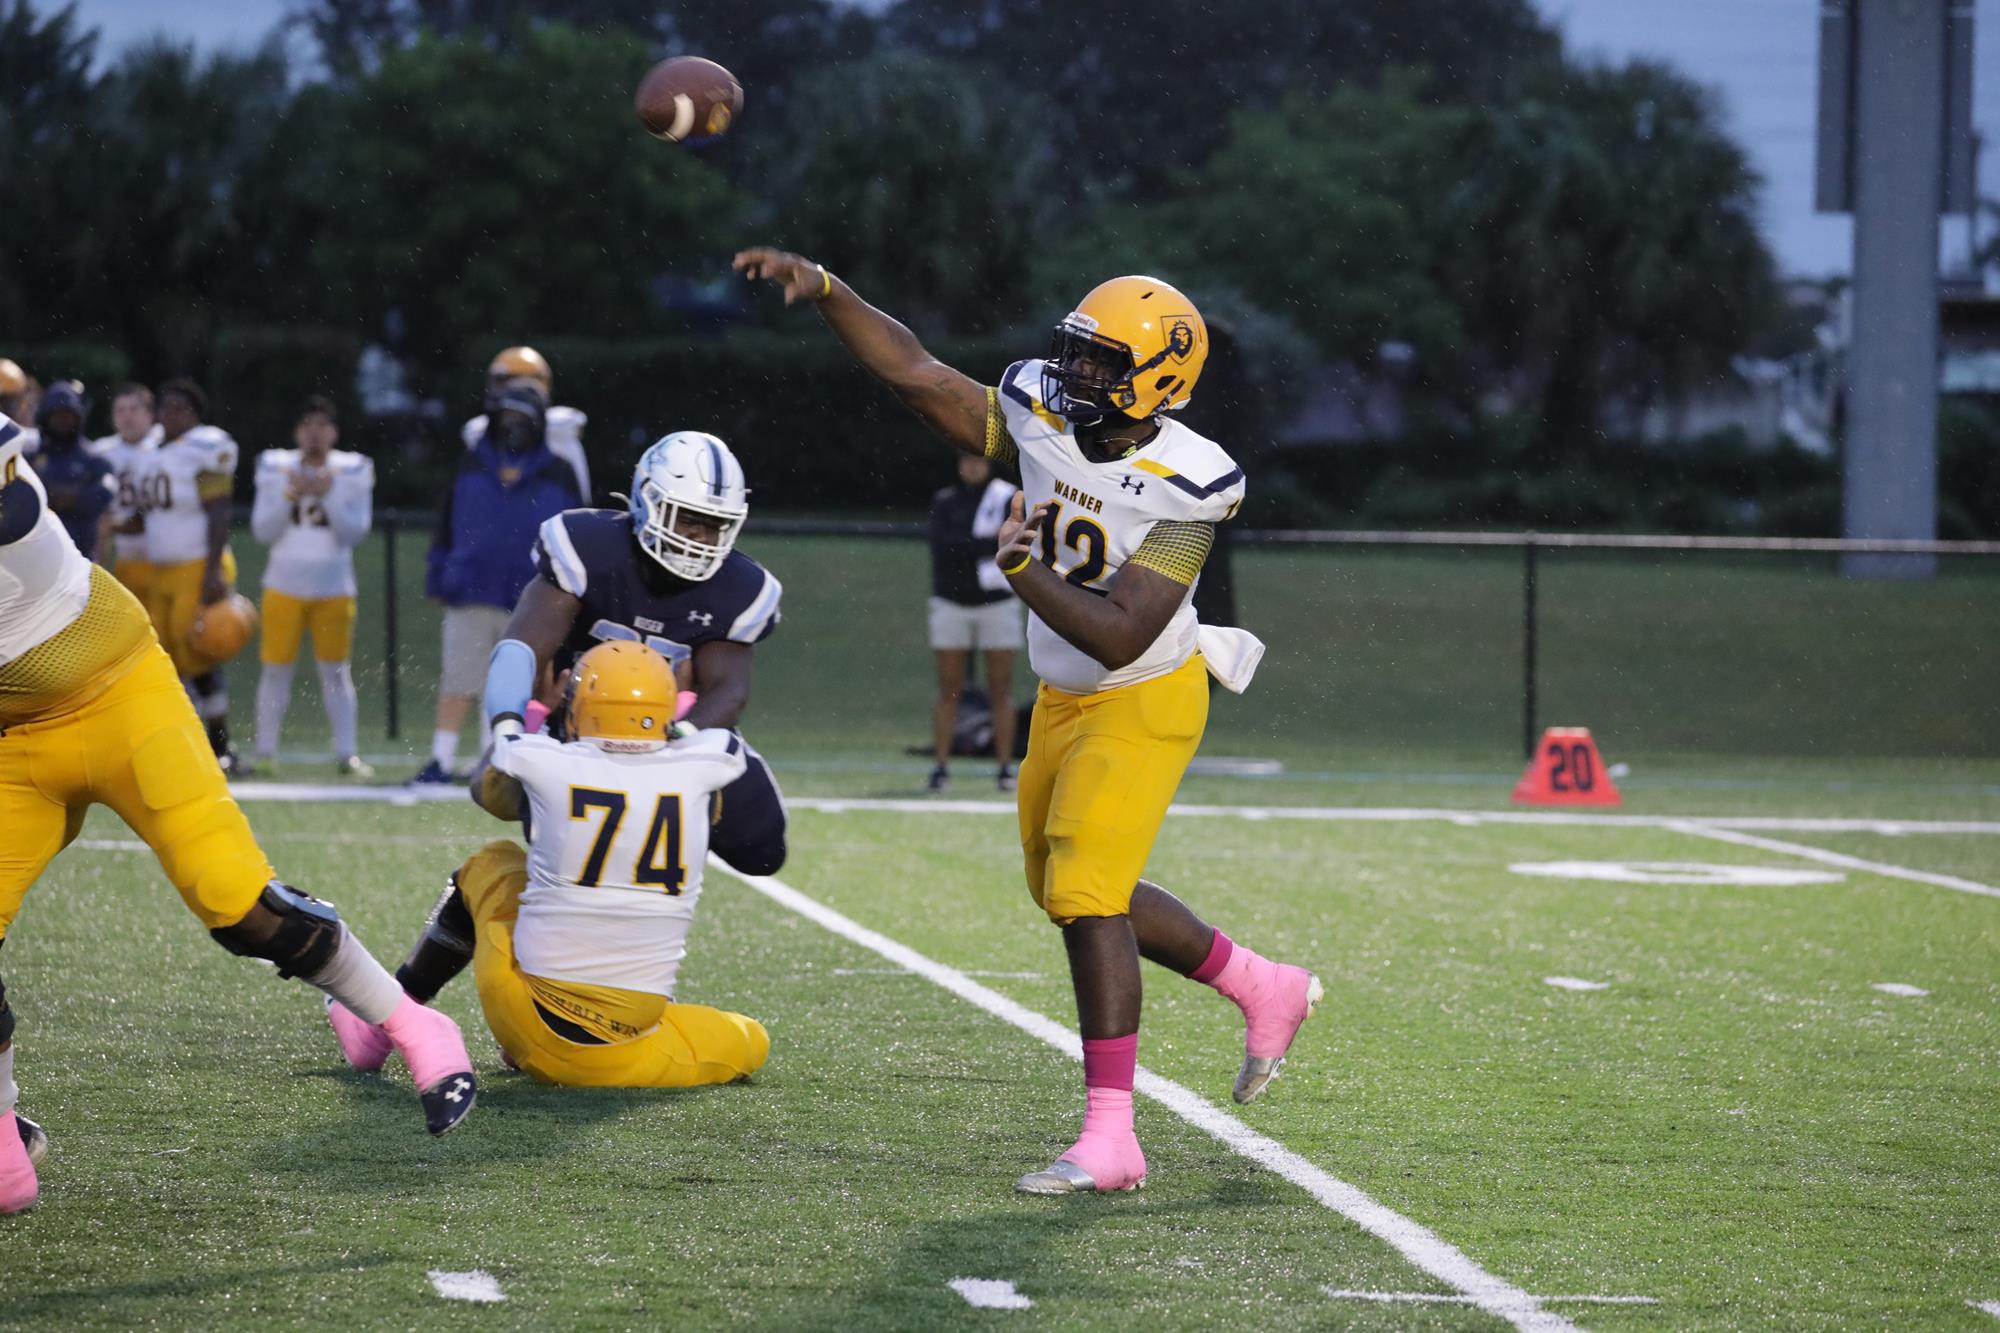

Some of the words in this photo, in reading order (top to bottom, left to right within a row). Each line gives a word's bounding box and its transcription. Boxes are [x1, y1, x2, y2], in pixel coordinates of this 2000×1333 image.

[1054, 479, 1103, 514] WARNER
[1034, 498, 1108, 598] 12
[1548, 743, 1594, 792] 20
[568, 783, 687, 896] 74
